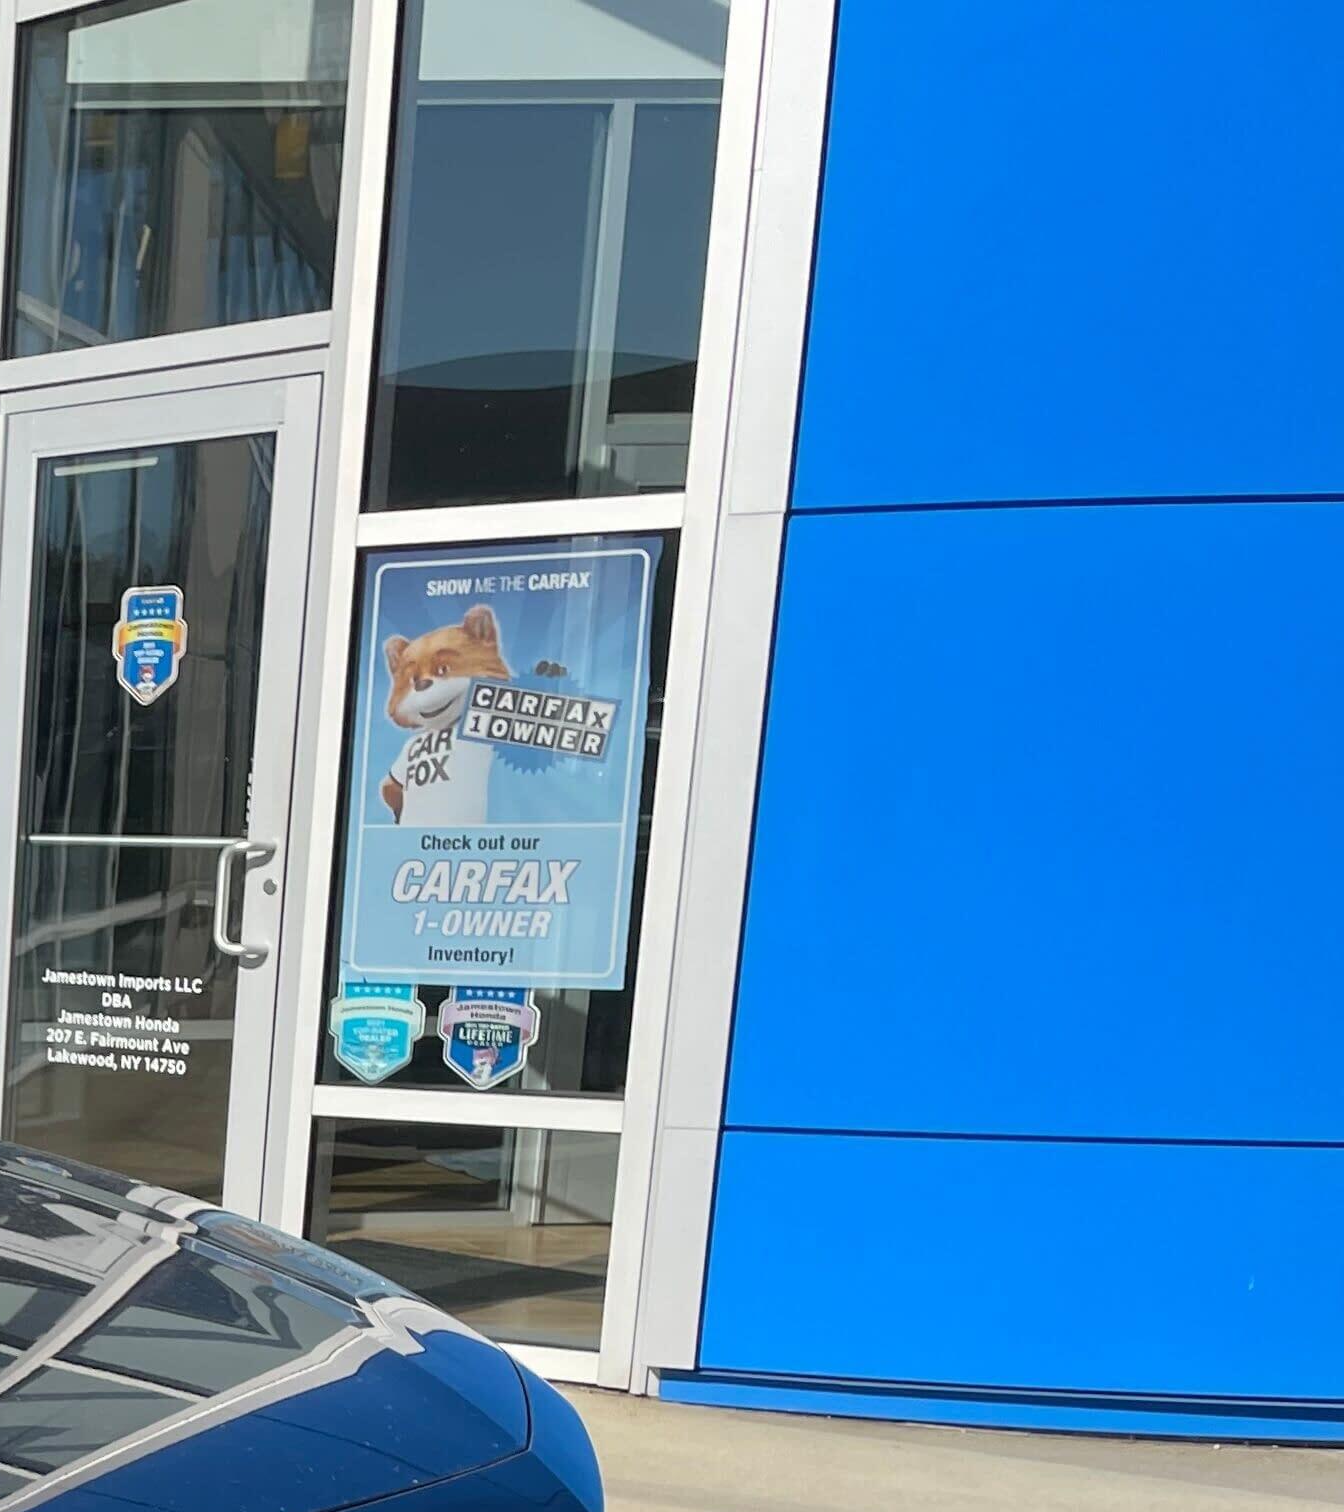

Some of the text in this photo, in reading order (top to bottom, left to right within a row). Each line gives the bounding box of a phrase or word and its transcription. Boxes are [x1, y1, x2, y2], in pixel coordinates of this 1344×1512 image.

[426, 571, 592, 597] SHOW ME THE CARFAX
[474, 684, 608, 730] CARFAX
[408, 727, 452, 762] CAR
[406, 755, 450, 791] FOX
[421, 834, 540, 850] Check out our
[391, 859, 582, 904] CARFAX
[413, 909, 553, 939] 1-OWNER
[428, 946, 514, 966] Inventory!
[42, 968, 203, 994] Jamestown Imports LLC
[101, 992, 132, 1009] DBA
[58, 1009, 180, 1034] Jamestown Honda
[46, 1028, 191, 1056] 207 E. Fairmount Ave
[458, 1027, 513, 1044] LIFETIME
[47, 1047, 187, 1075] Lakewood, NY 14750
